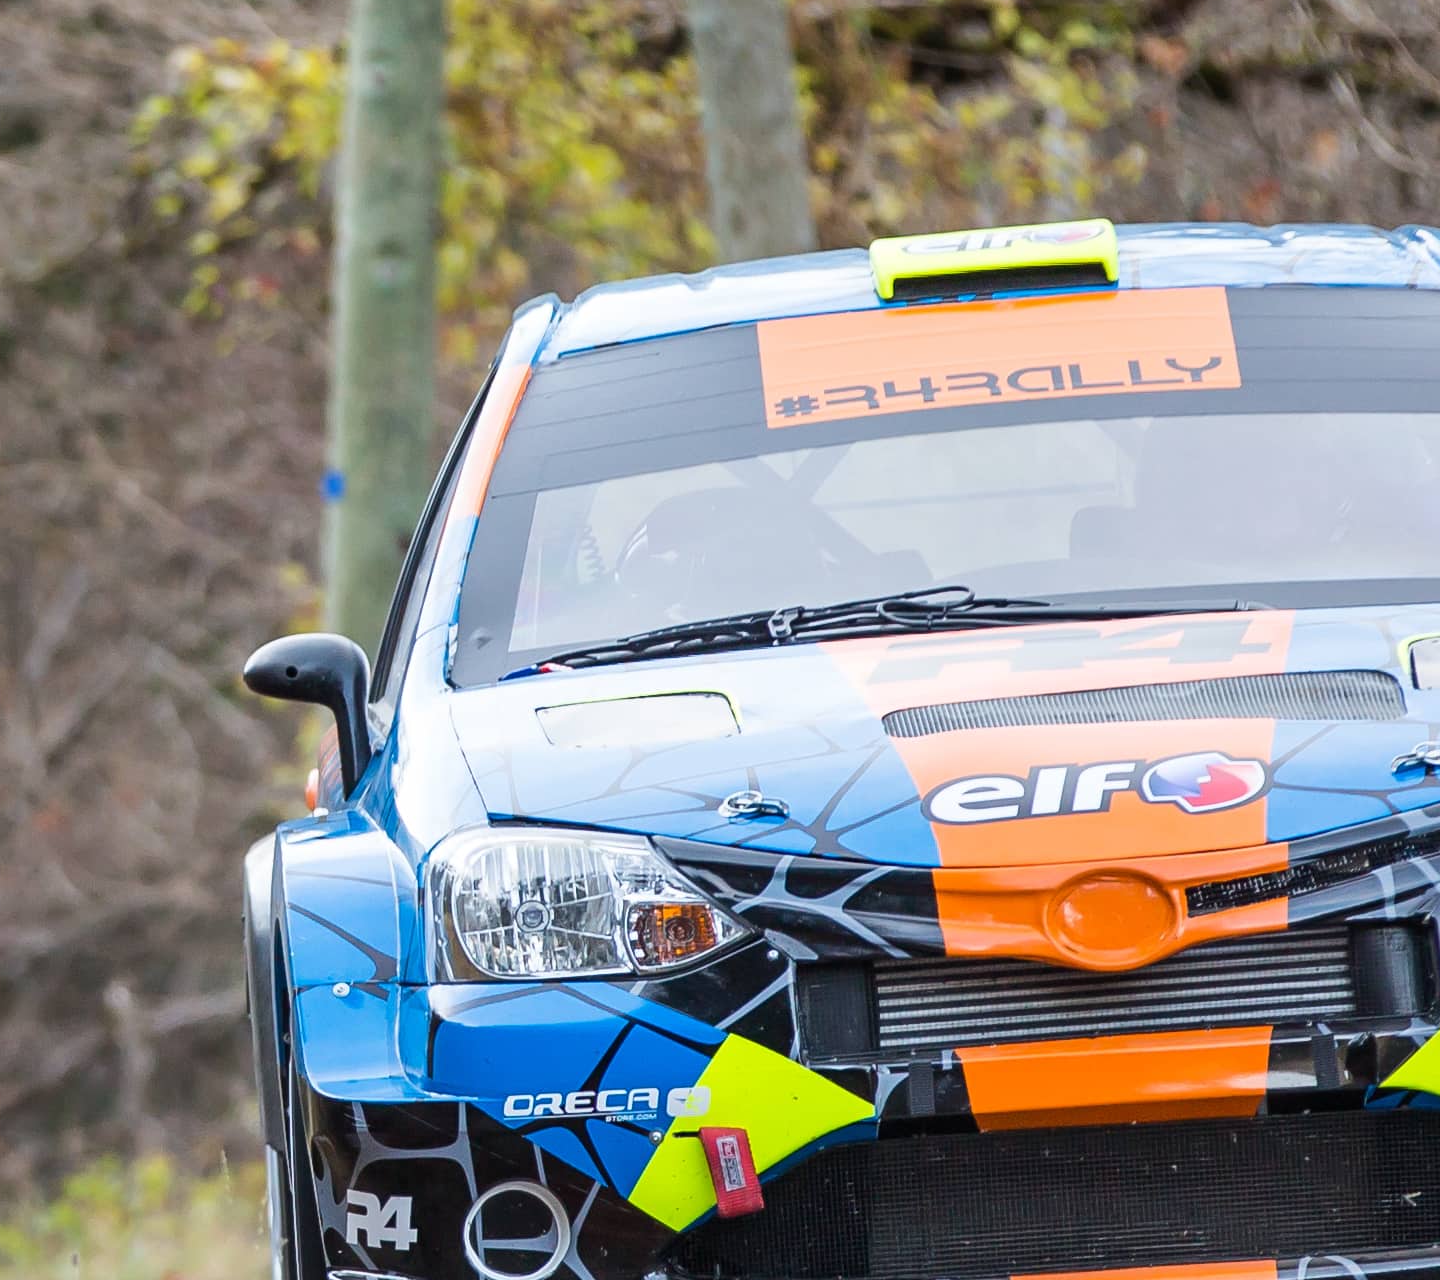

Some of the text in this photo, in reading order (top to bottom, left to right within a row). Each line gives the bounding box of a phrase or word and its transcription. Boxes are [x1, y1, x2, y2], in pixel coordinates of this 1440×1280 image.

[924, 759, 1140, 823] elf
[504, 1087, 660, 1117] ORECA
[605, 1112, 657, 1123] STORE.COM
[346, 1188, 418, 1251] R4
